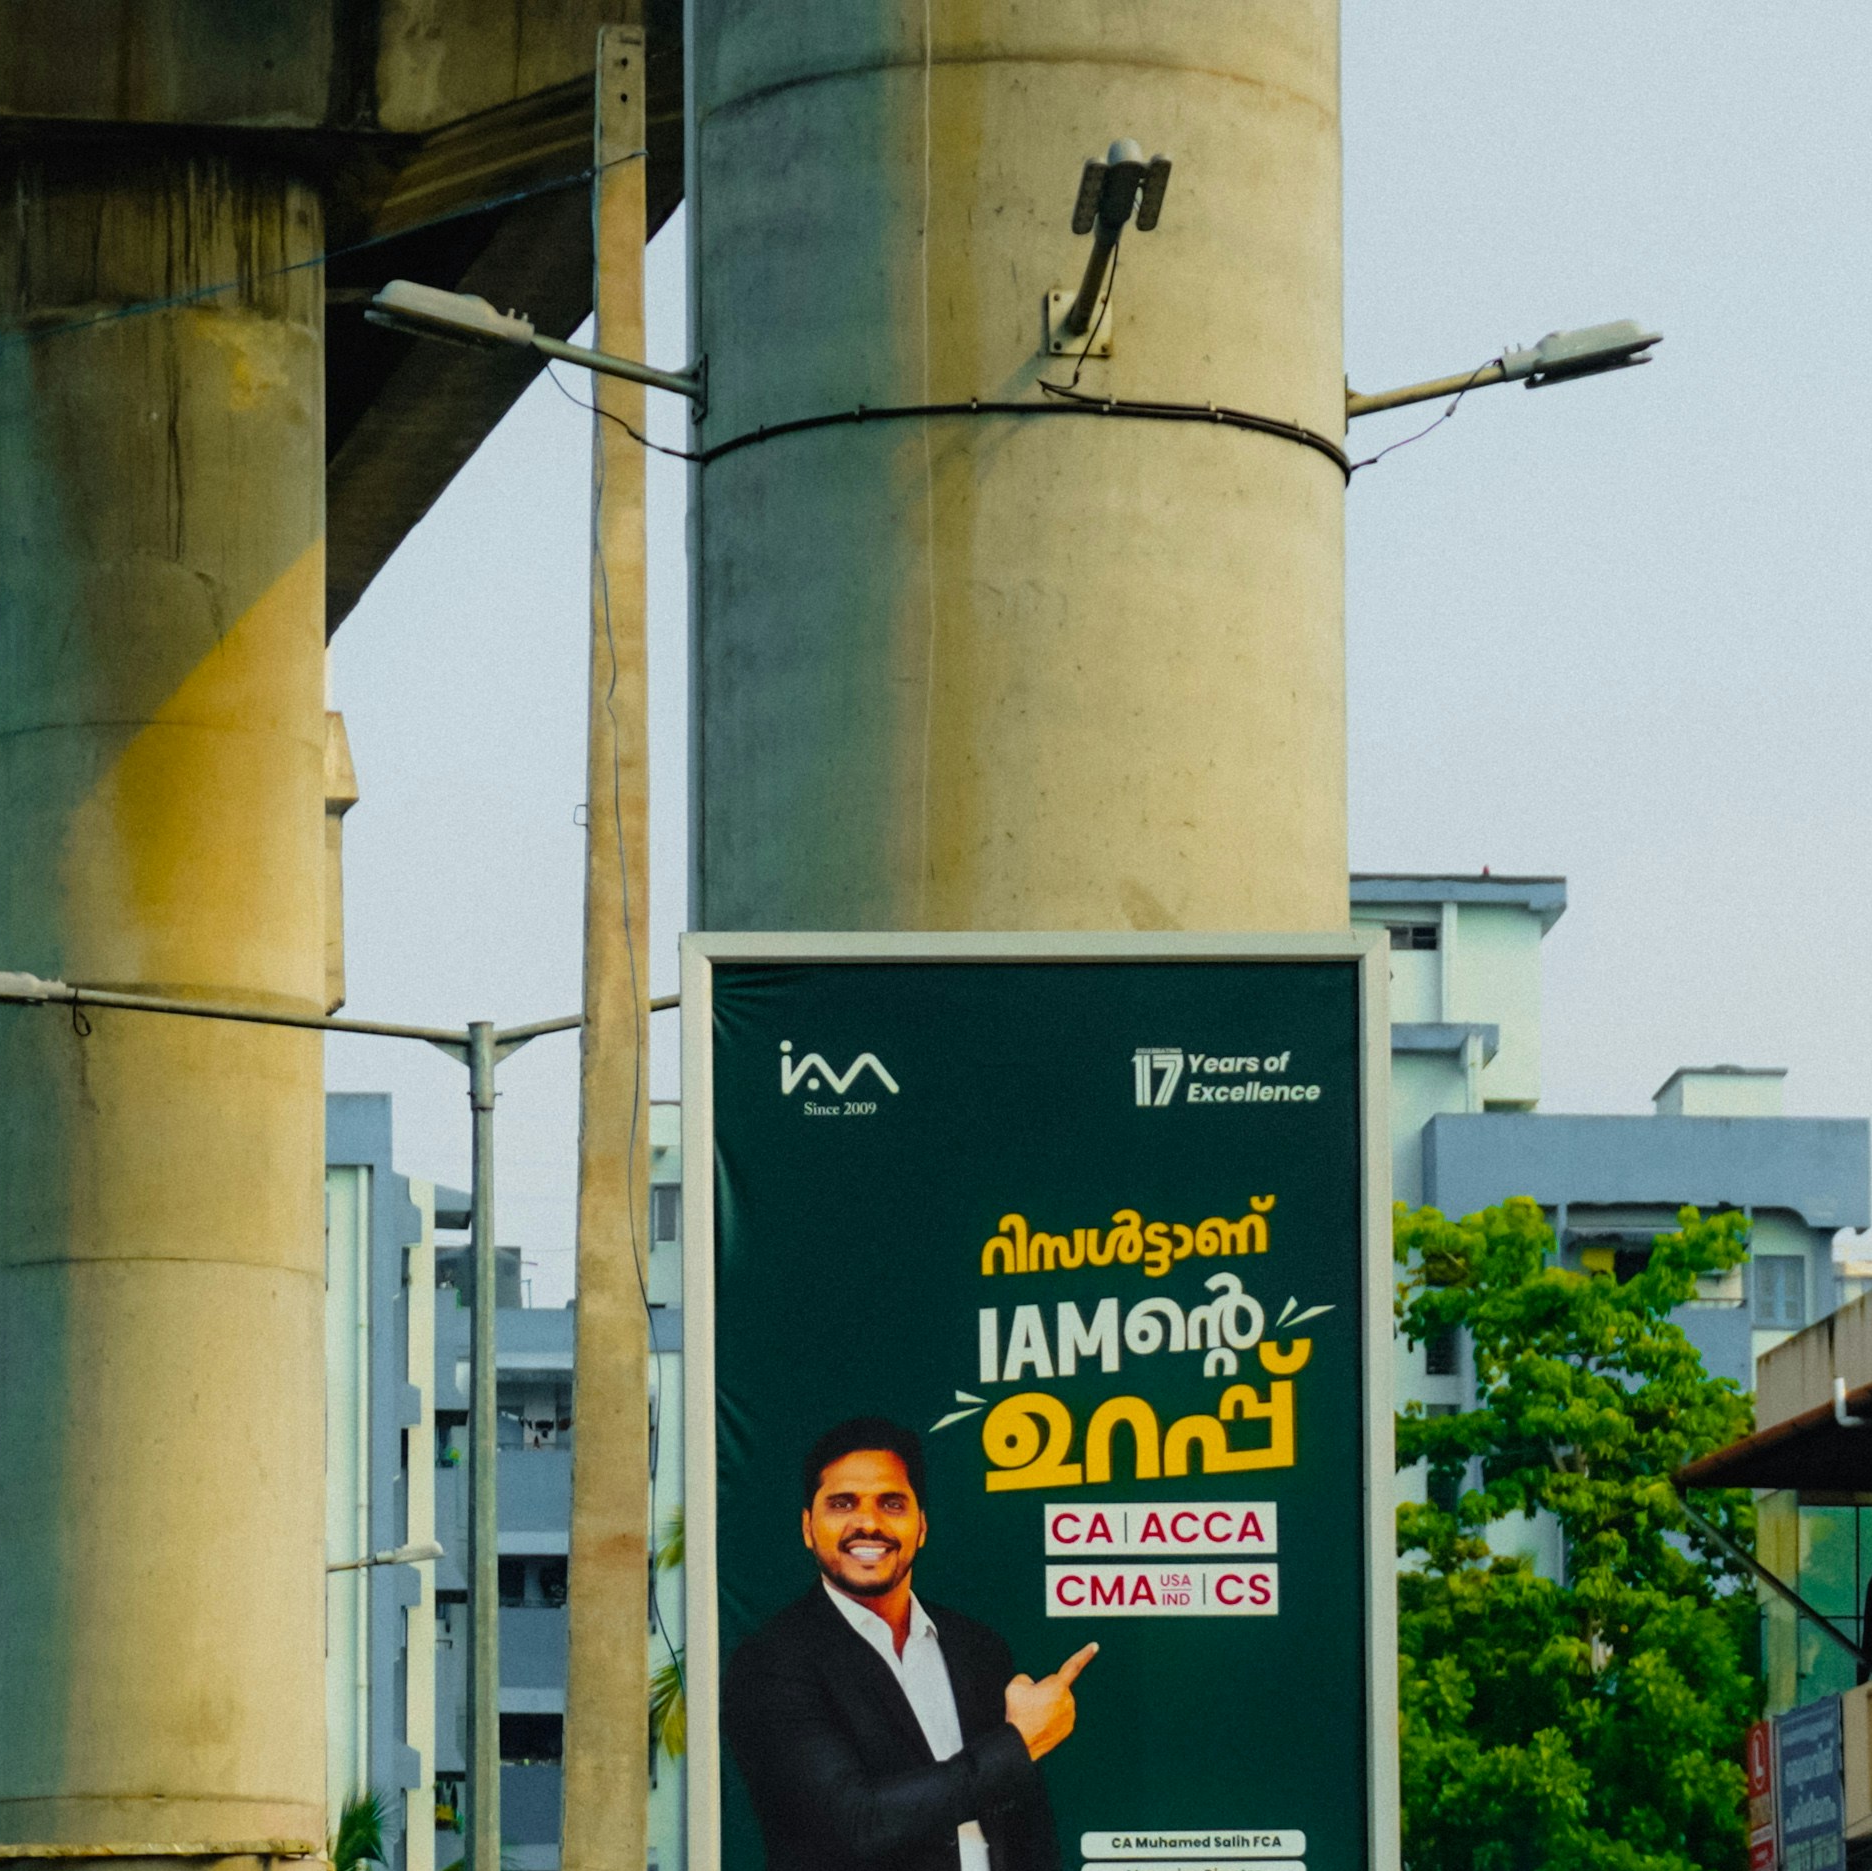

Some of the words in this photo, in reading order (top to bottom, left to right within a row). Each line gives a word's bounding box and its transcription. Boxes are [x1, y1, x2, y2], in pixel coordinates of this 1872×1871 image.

[1188, 1053, 1260, 1073] Years
[1263, 1050, 1291, 1073] of
[1131, 1054, 1184, 1106] 17
[1187, 1081, 1321, 1102] Excellence
[803, 1101, 840, 1115] Since
[843, 1101, 878, 1115] 2009
[1051, 1511, 1114, 1544] CA
[1139, 1511, 1265, 1543] ACCA
[1056, 1574, 1157, 1606] CMA
[1215, 1573, 1271, 1605] CS
[1160, 1574, 1192, 1587] USA
[1162, 1593, 1191, 1606] IND
[1111, 1837, 1132, 1849] CA
[1135, 1836, 1211, 1849] Muhamed
[1214, 1834, 1250, 1848] Salih
[1253, 1836, 1282, 1848] FCA
